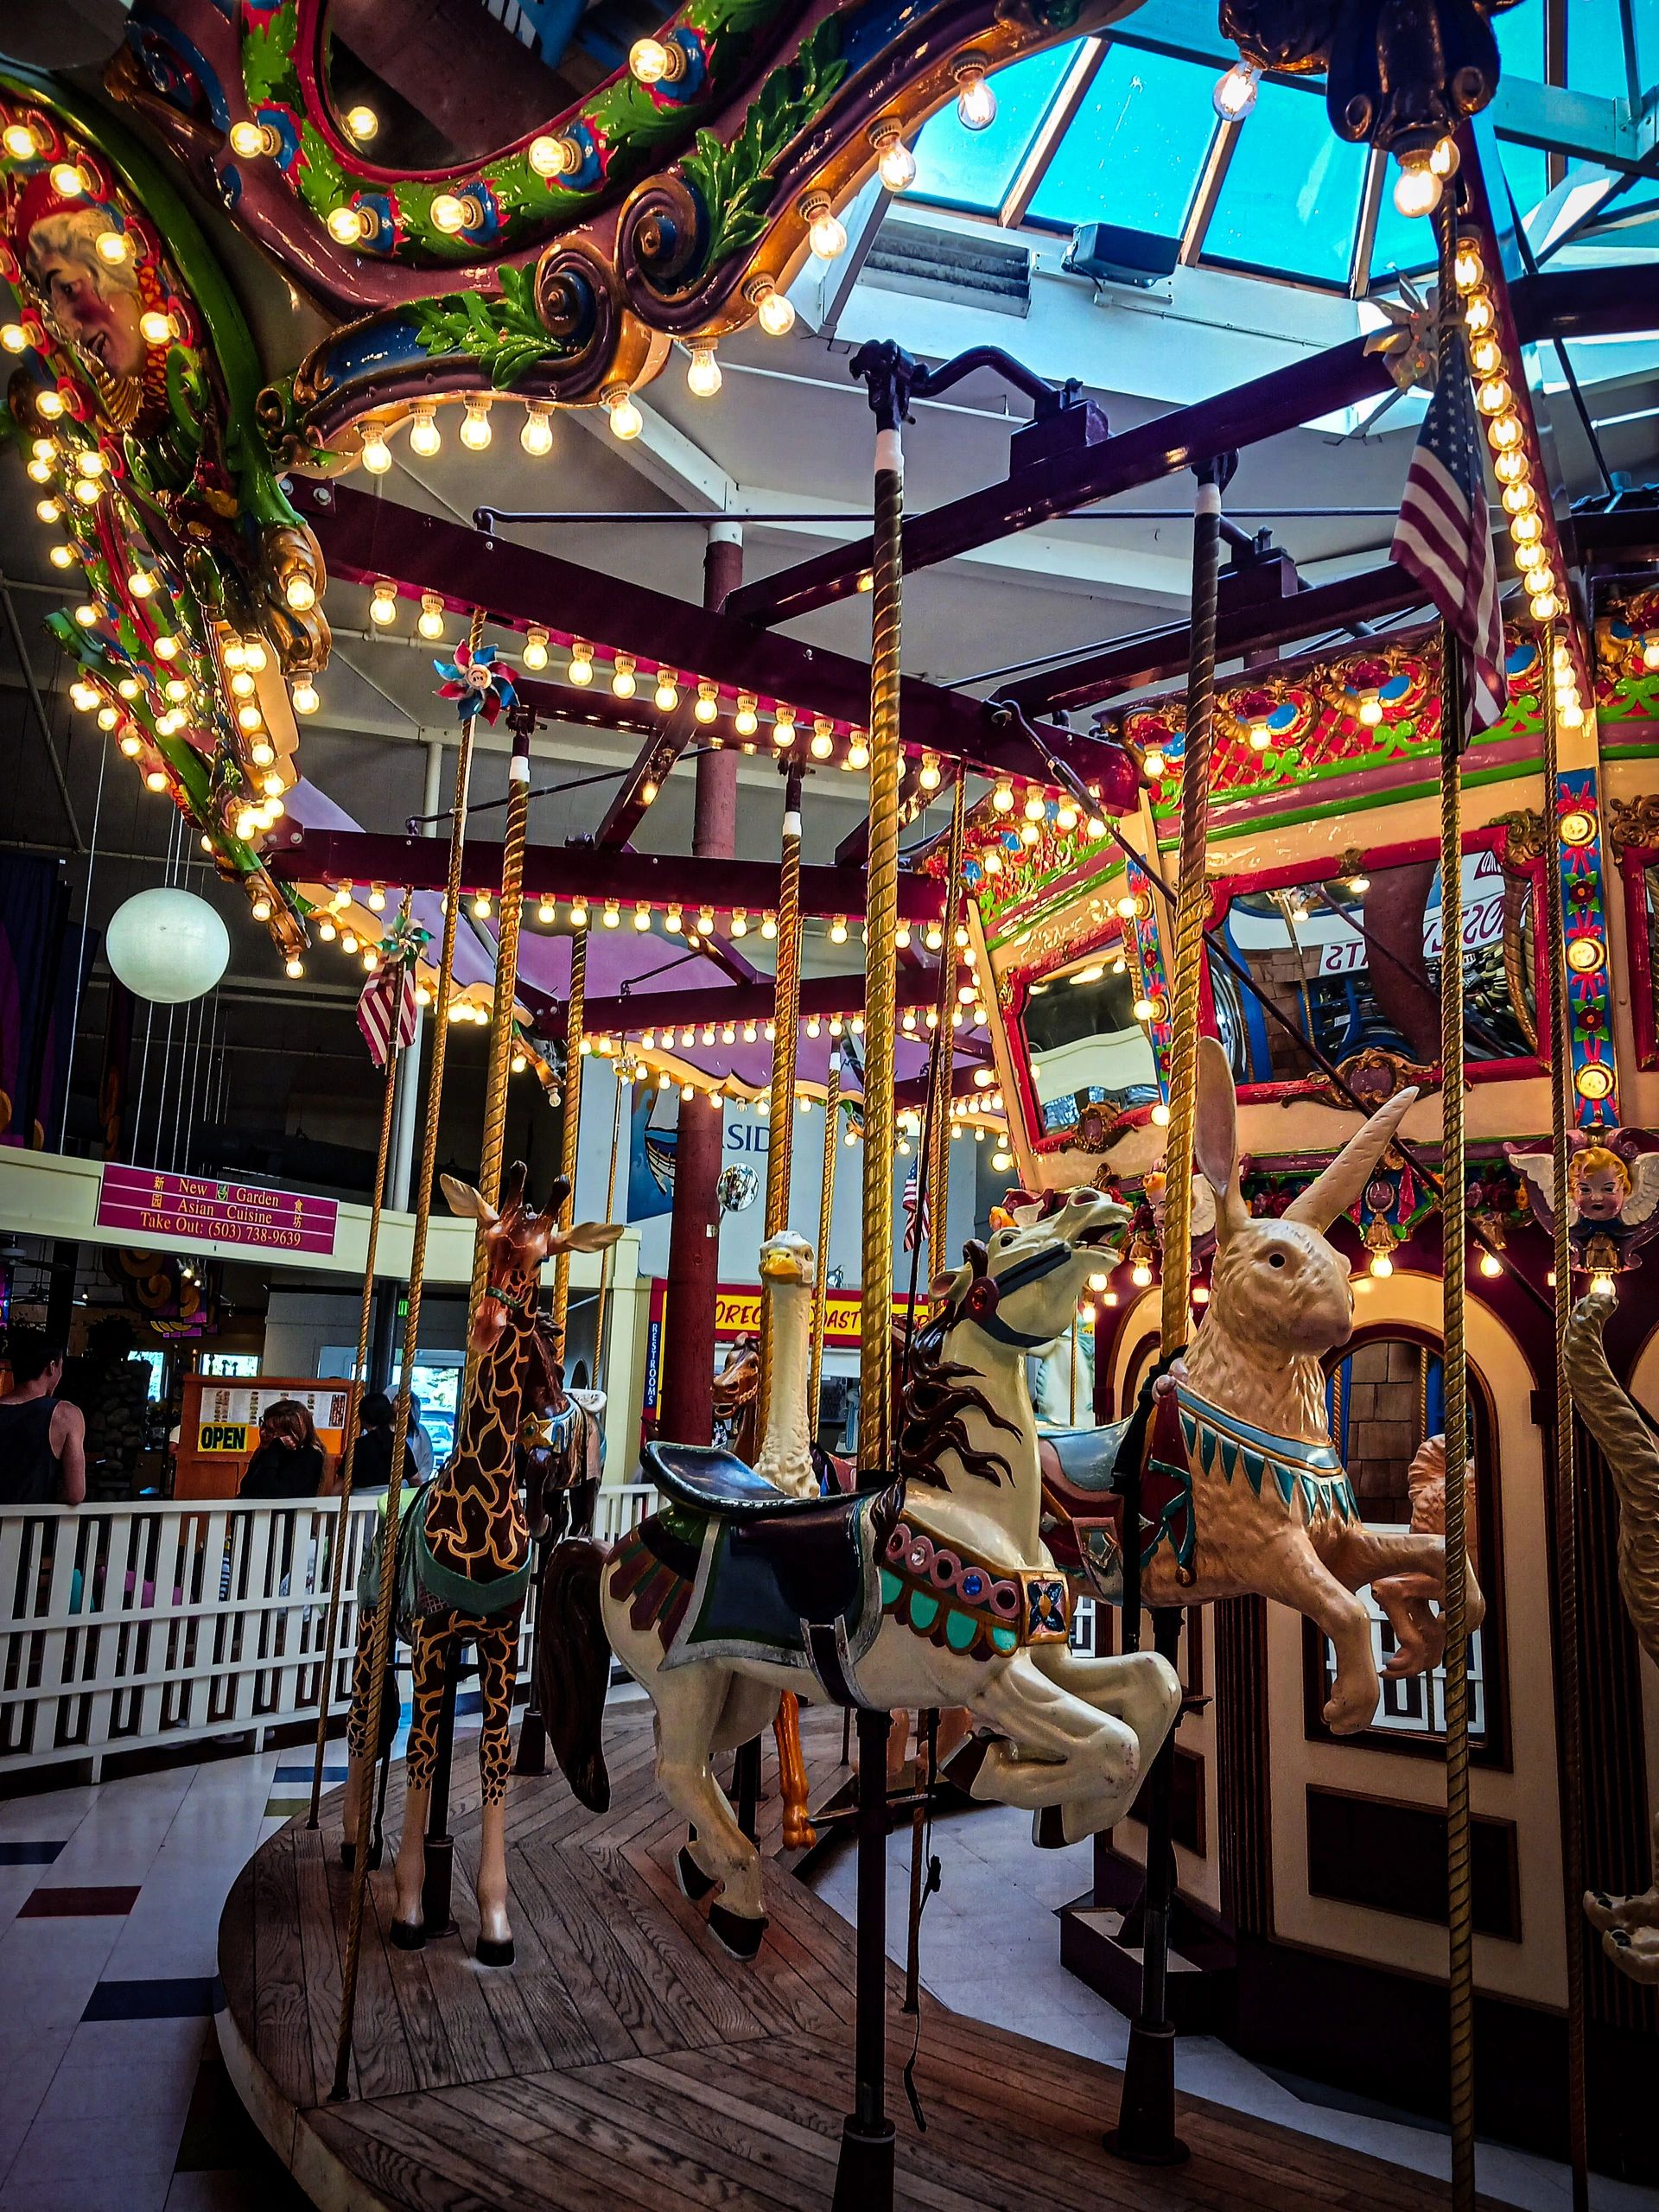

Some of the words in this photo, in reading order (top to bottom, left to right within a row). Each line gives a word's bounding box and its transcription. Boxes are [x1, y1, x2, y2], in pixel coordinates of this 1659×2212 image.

[178, 1178, 208, 1196] New
[236, 1187, 279, 1207] Garden
[177, 1198, 214, 1217] Asian
[226, 1205, 272, 1224] Cuisine
[140, 1211, 171, 1230] Take
[175, 1217, 204, 1234] Out:
[208, 1222, 241, 1241] (503)
[246, 1226, 301, 1246] 738-9639
[647, 1323, 658, 1405] RESTROOMS
[201, 1426, 246, 1450] OPEN
